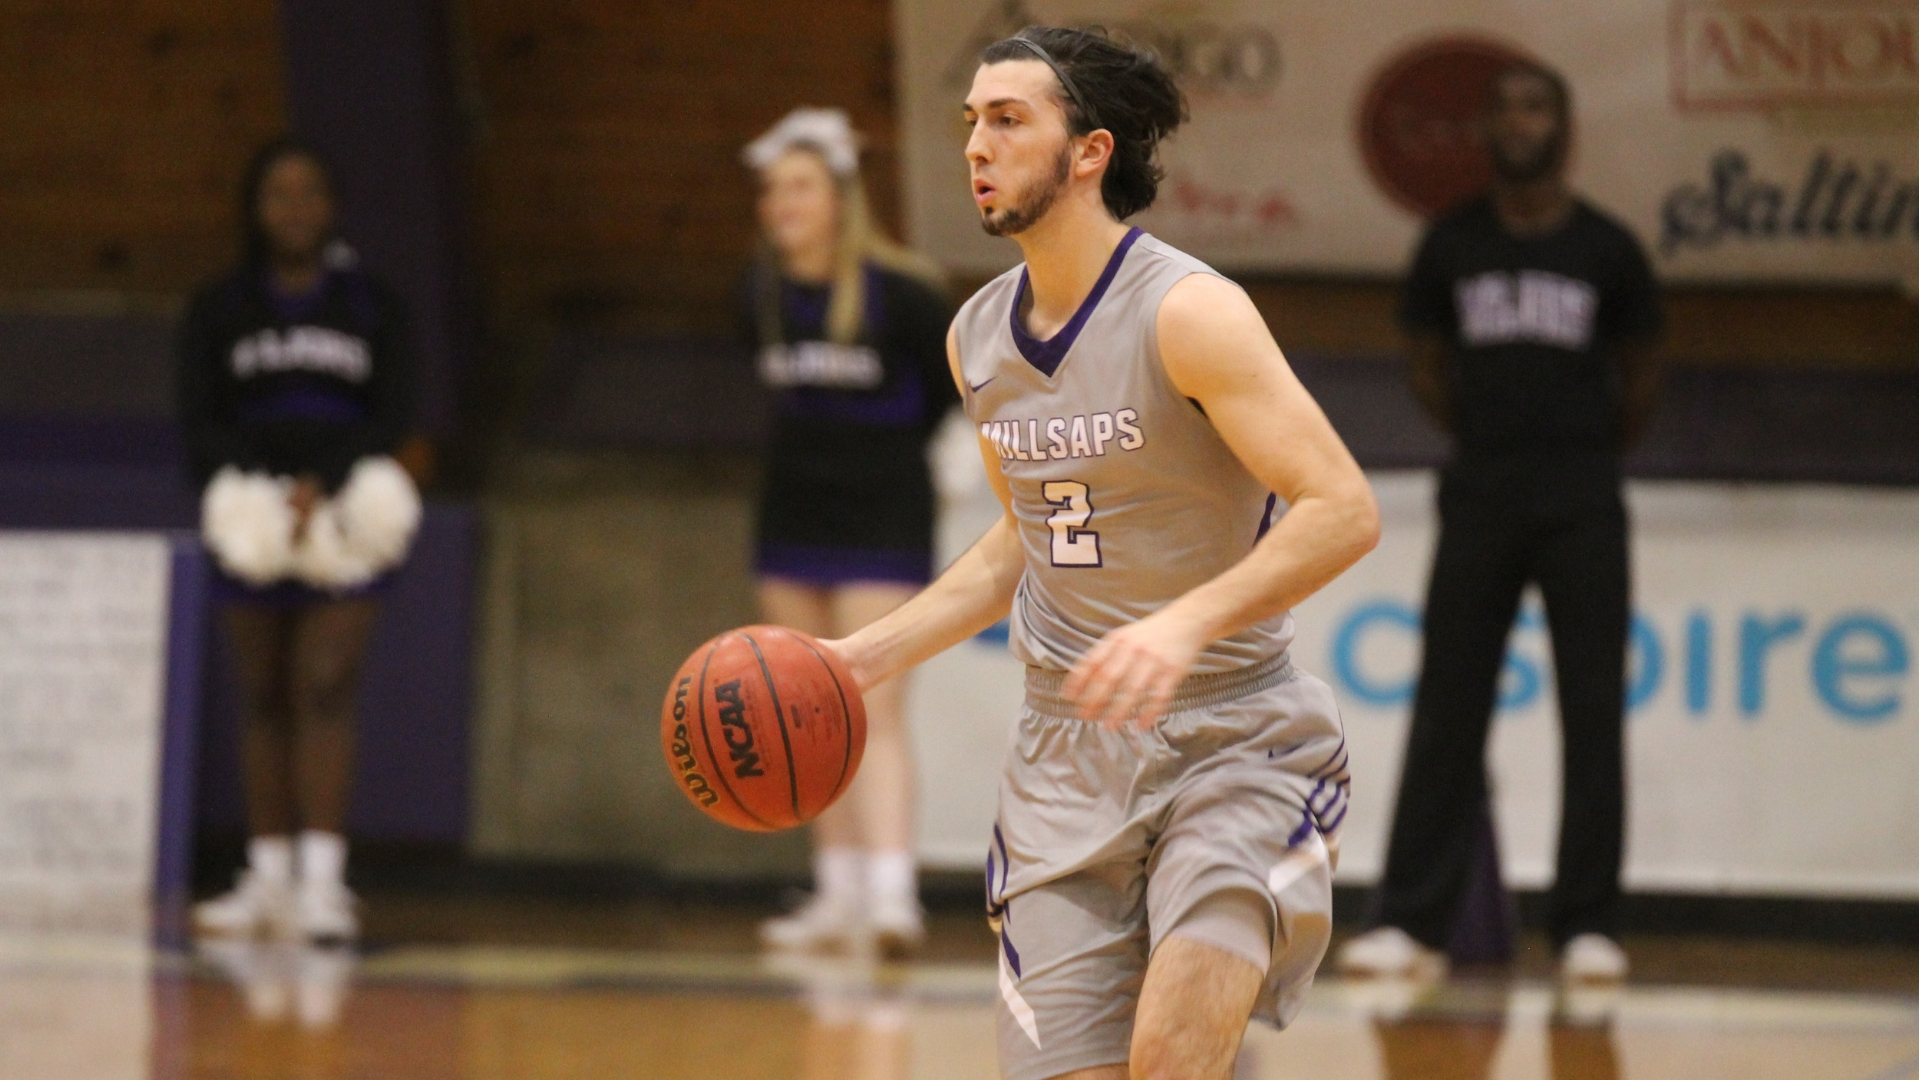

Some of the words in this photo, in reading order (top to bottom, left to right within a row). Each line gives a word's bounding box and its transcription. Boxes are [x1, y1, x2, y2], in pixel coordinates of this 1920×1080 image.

[981, 407, 1146, 462] MILLSAPS
[1041, 479, 1102, 568] 2
[714, 678, 765, 779] NCAA
